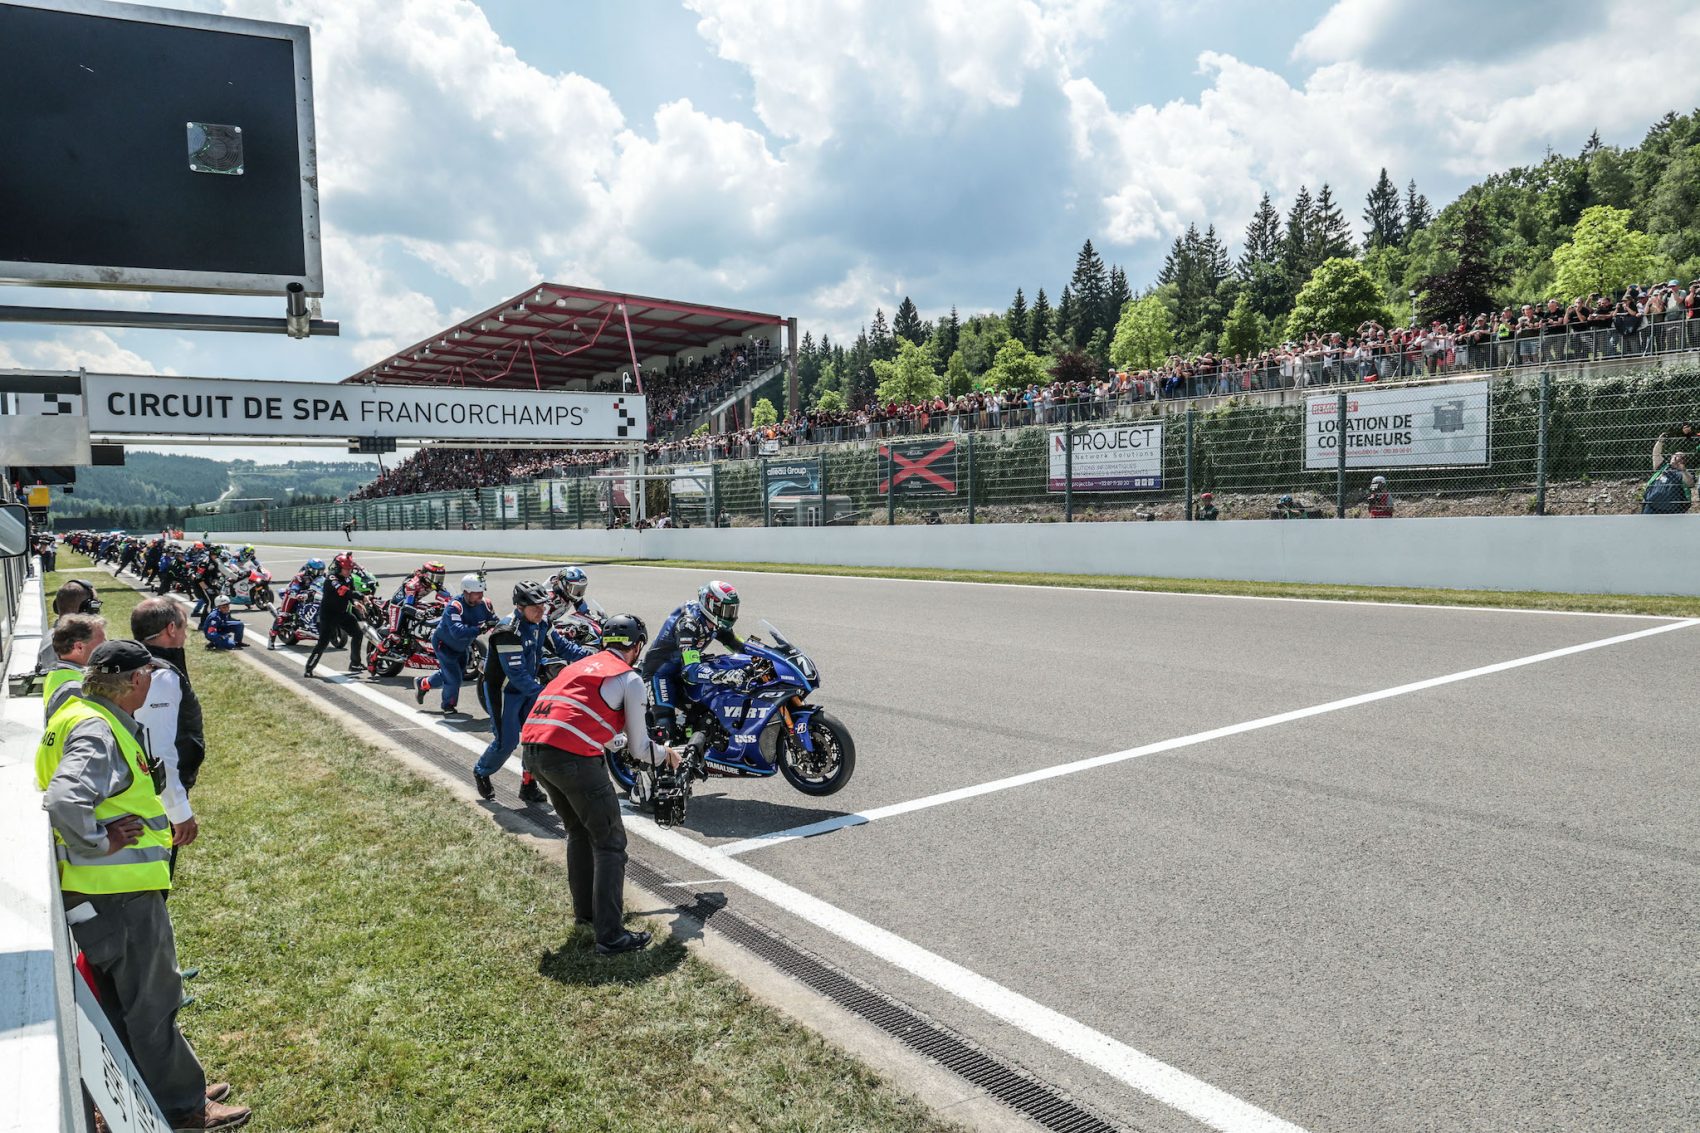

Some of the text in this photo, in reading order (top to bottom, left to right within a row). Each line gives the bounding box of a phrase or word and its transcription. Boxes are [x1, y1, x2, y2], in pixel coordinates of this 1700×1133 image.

[107, 391, 233, 419] CIRCUIT
[244, 395, 283, 420] DE
[293, 398, 348, 422] SPA
[1393, 414, 1412, 429] DE
[1318, 431, 1412, 449] COTENEURS
[533, 701, 553, 718] 44
[724, 706, 771, 719] YART
